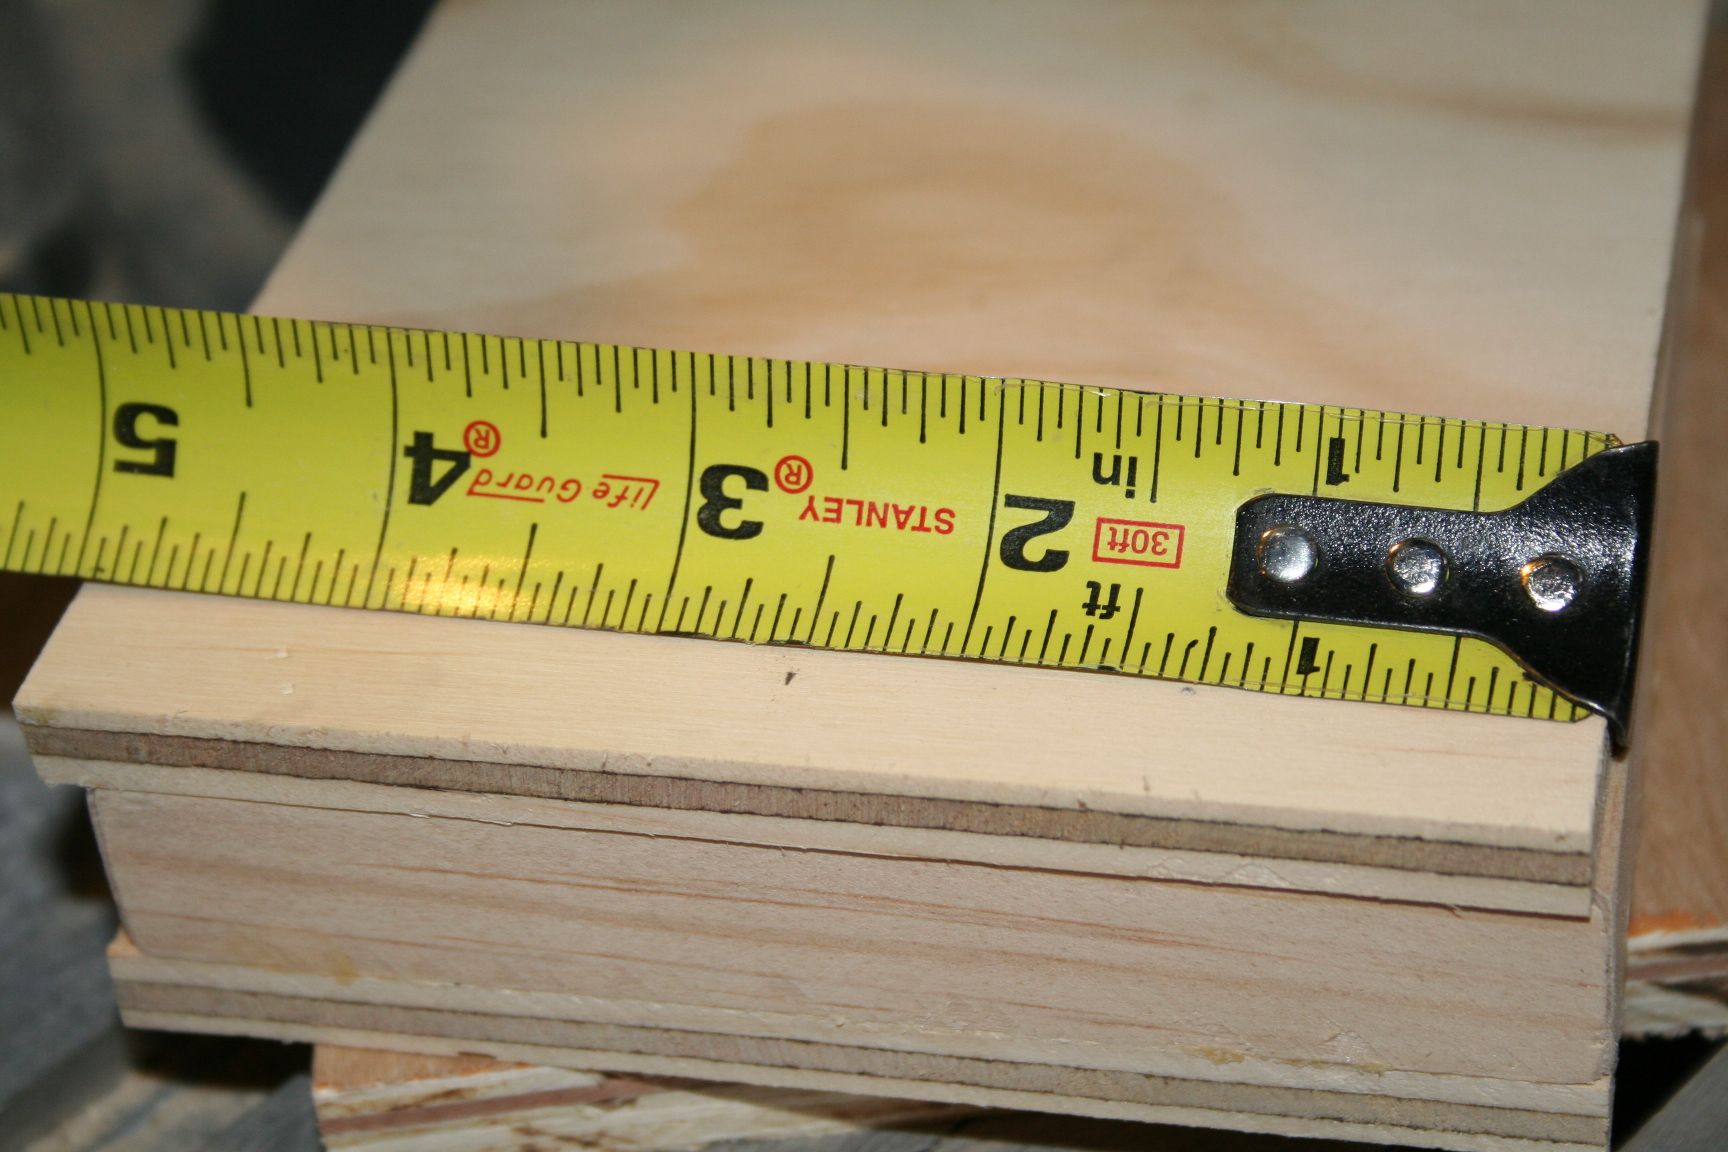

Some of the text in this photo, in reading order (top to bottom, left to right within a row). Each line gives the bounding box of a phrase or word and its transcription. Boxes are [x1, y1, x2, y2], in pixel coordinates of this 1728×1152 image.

[113, 402, 179, 478] 5
[1326, 437, 1350, 486] 1
[404, 431, 471, 506] 4
[466, 468, 582, 503] Guard
[1092, 452, 1138, 498] in
[697, 463, 769, 540] 3
[799, 495, 956, 535] STANLEY
[999, 493, 1076, 573] 2
[1106, 526, 1171, 556] 30ft
[1082, 581, 1121, 620] ft
[1296, 637, 1320, 676] 1
